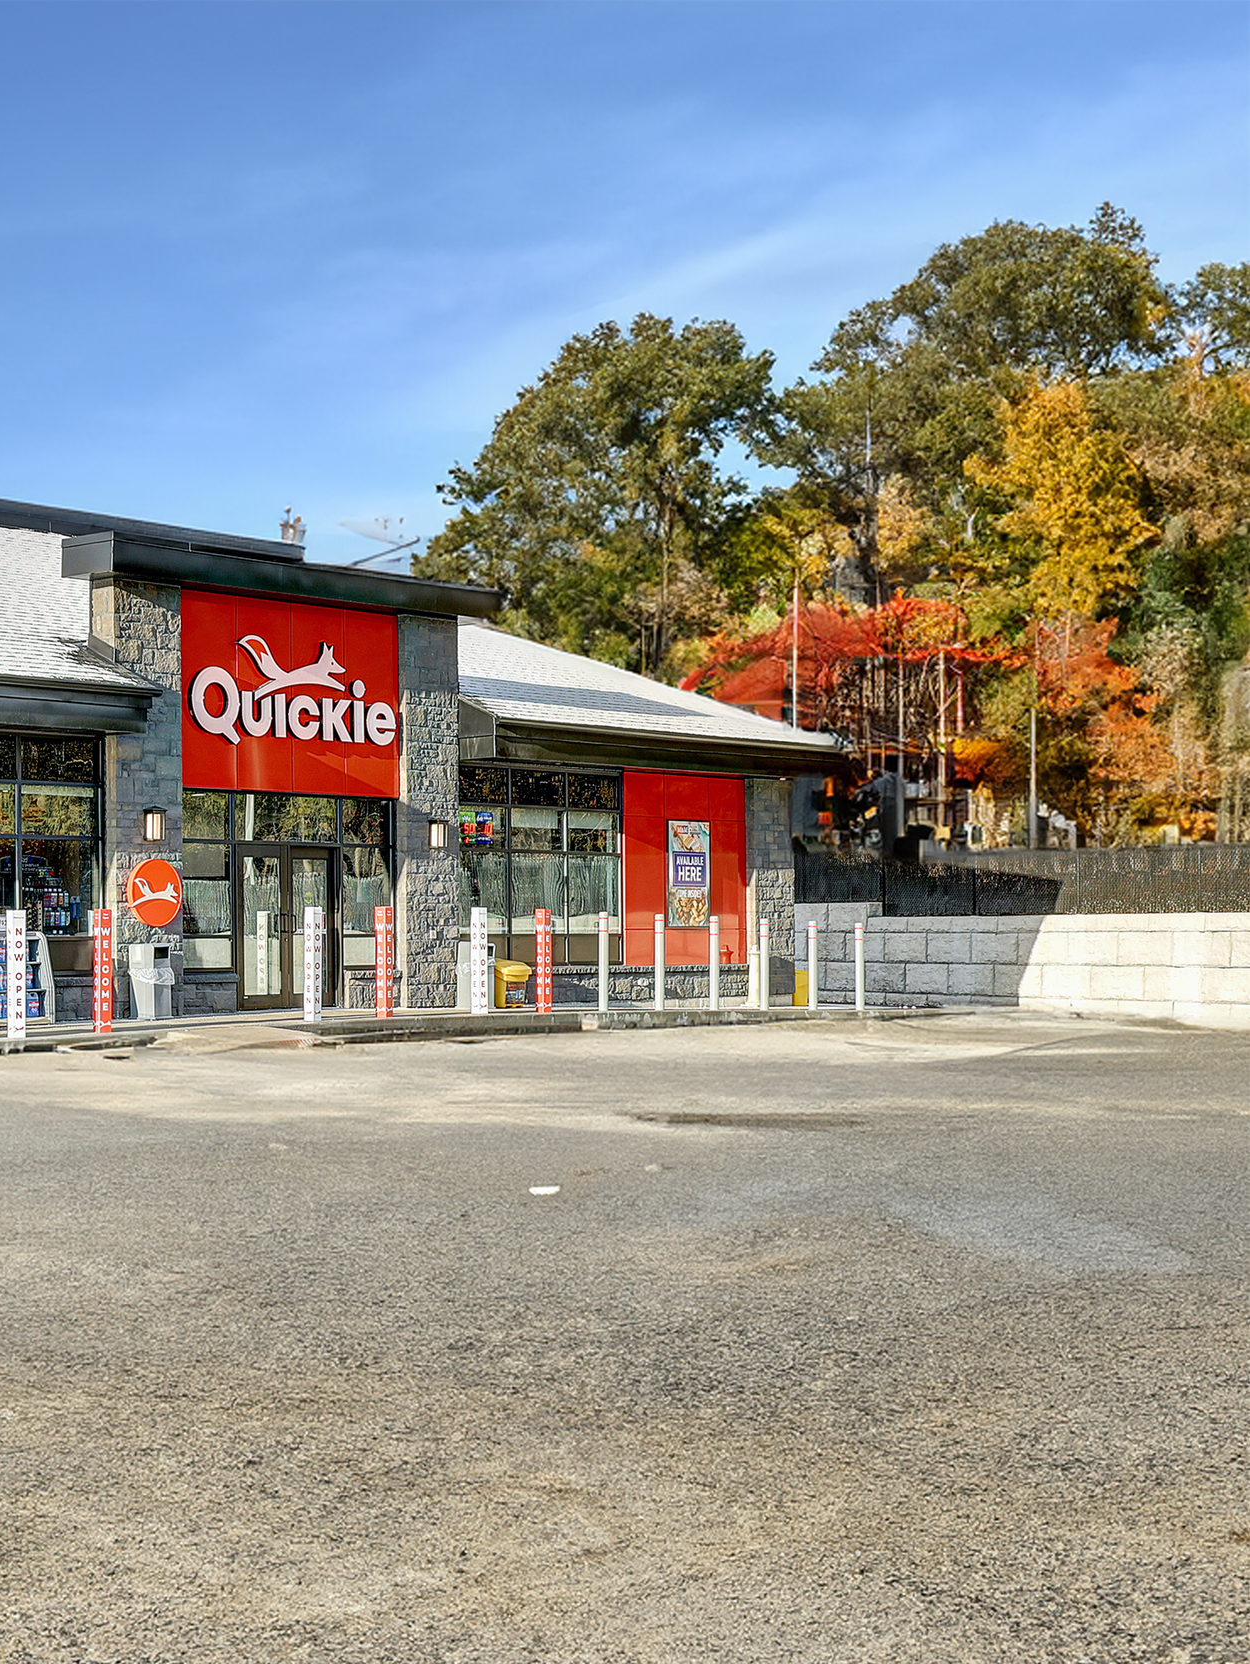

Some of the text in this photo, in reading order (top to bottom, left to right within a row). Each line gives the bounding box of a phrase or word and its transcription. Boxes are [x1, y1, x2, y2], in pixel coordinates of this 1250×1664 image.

[676, 855, 705, 866] AVAILABLE
[677, 866, 702, 882] HERE
[14, 927, 24, 962] NOW
[375, 923, 384, 999] WELCOME
[385, 923, 393, 999] WELCOME
[100, 927, 111, 1012] WELCOME
[14, 972, 24, 1020] OPEN
